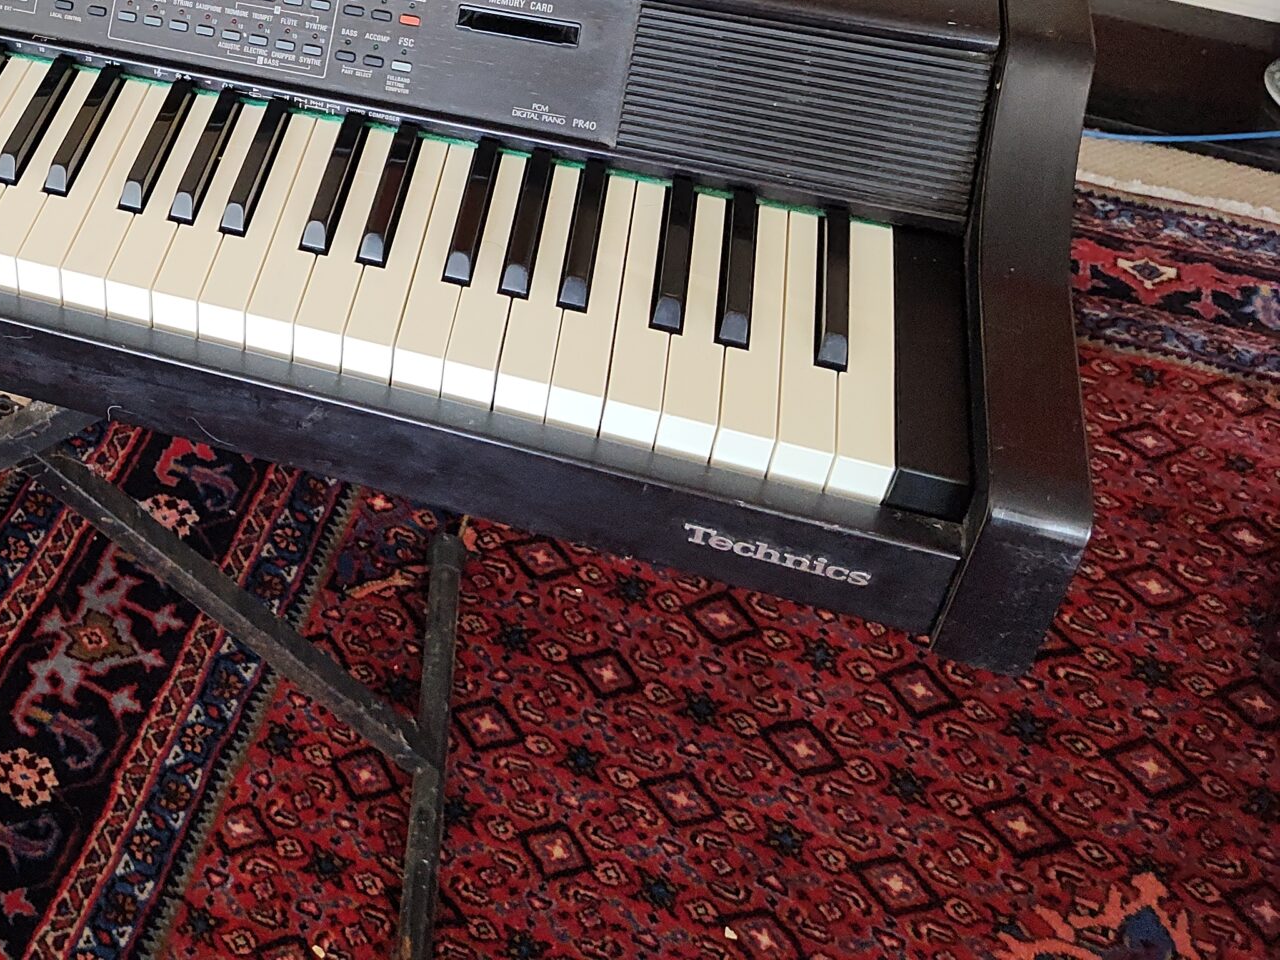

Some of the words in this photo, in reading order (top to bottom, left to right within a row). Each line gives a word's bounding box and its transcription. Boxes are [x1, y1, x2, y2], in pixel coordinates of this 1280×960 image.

[530, 2, 554, 13] CARD
[280, 18, 298, 27] FLUTE
[305, 22, 328, 31] SYNTHE
[341, 28, 358, 37] BASS
[365, 32, 390, 42] ACCOMP
[218, 42, 240, 52] ACOUSTIC
[399, 37, 414, 47] FSC
[244, 46, 268, 56] ELECTRIC
[271, 51, 296, 61] CHOPPER
[264, 57, 279, 66] BASS
[299, 56, 322, 66] SYNTHE
[532, 103, 548, 112] PCM
[369, 112, 400, 122] COMPOSER
[512, 109, 539, 120] DIGITAL
[542, 115, 566, 125] PIANO
[572, 118, 596, 130] PR40
[684, 523, 872, 586] Technics
